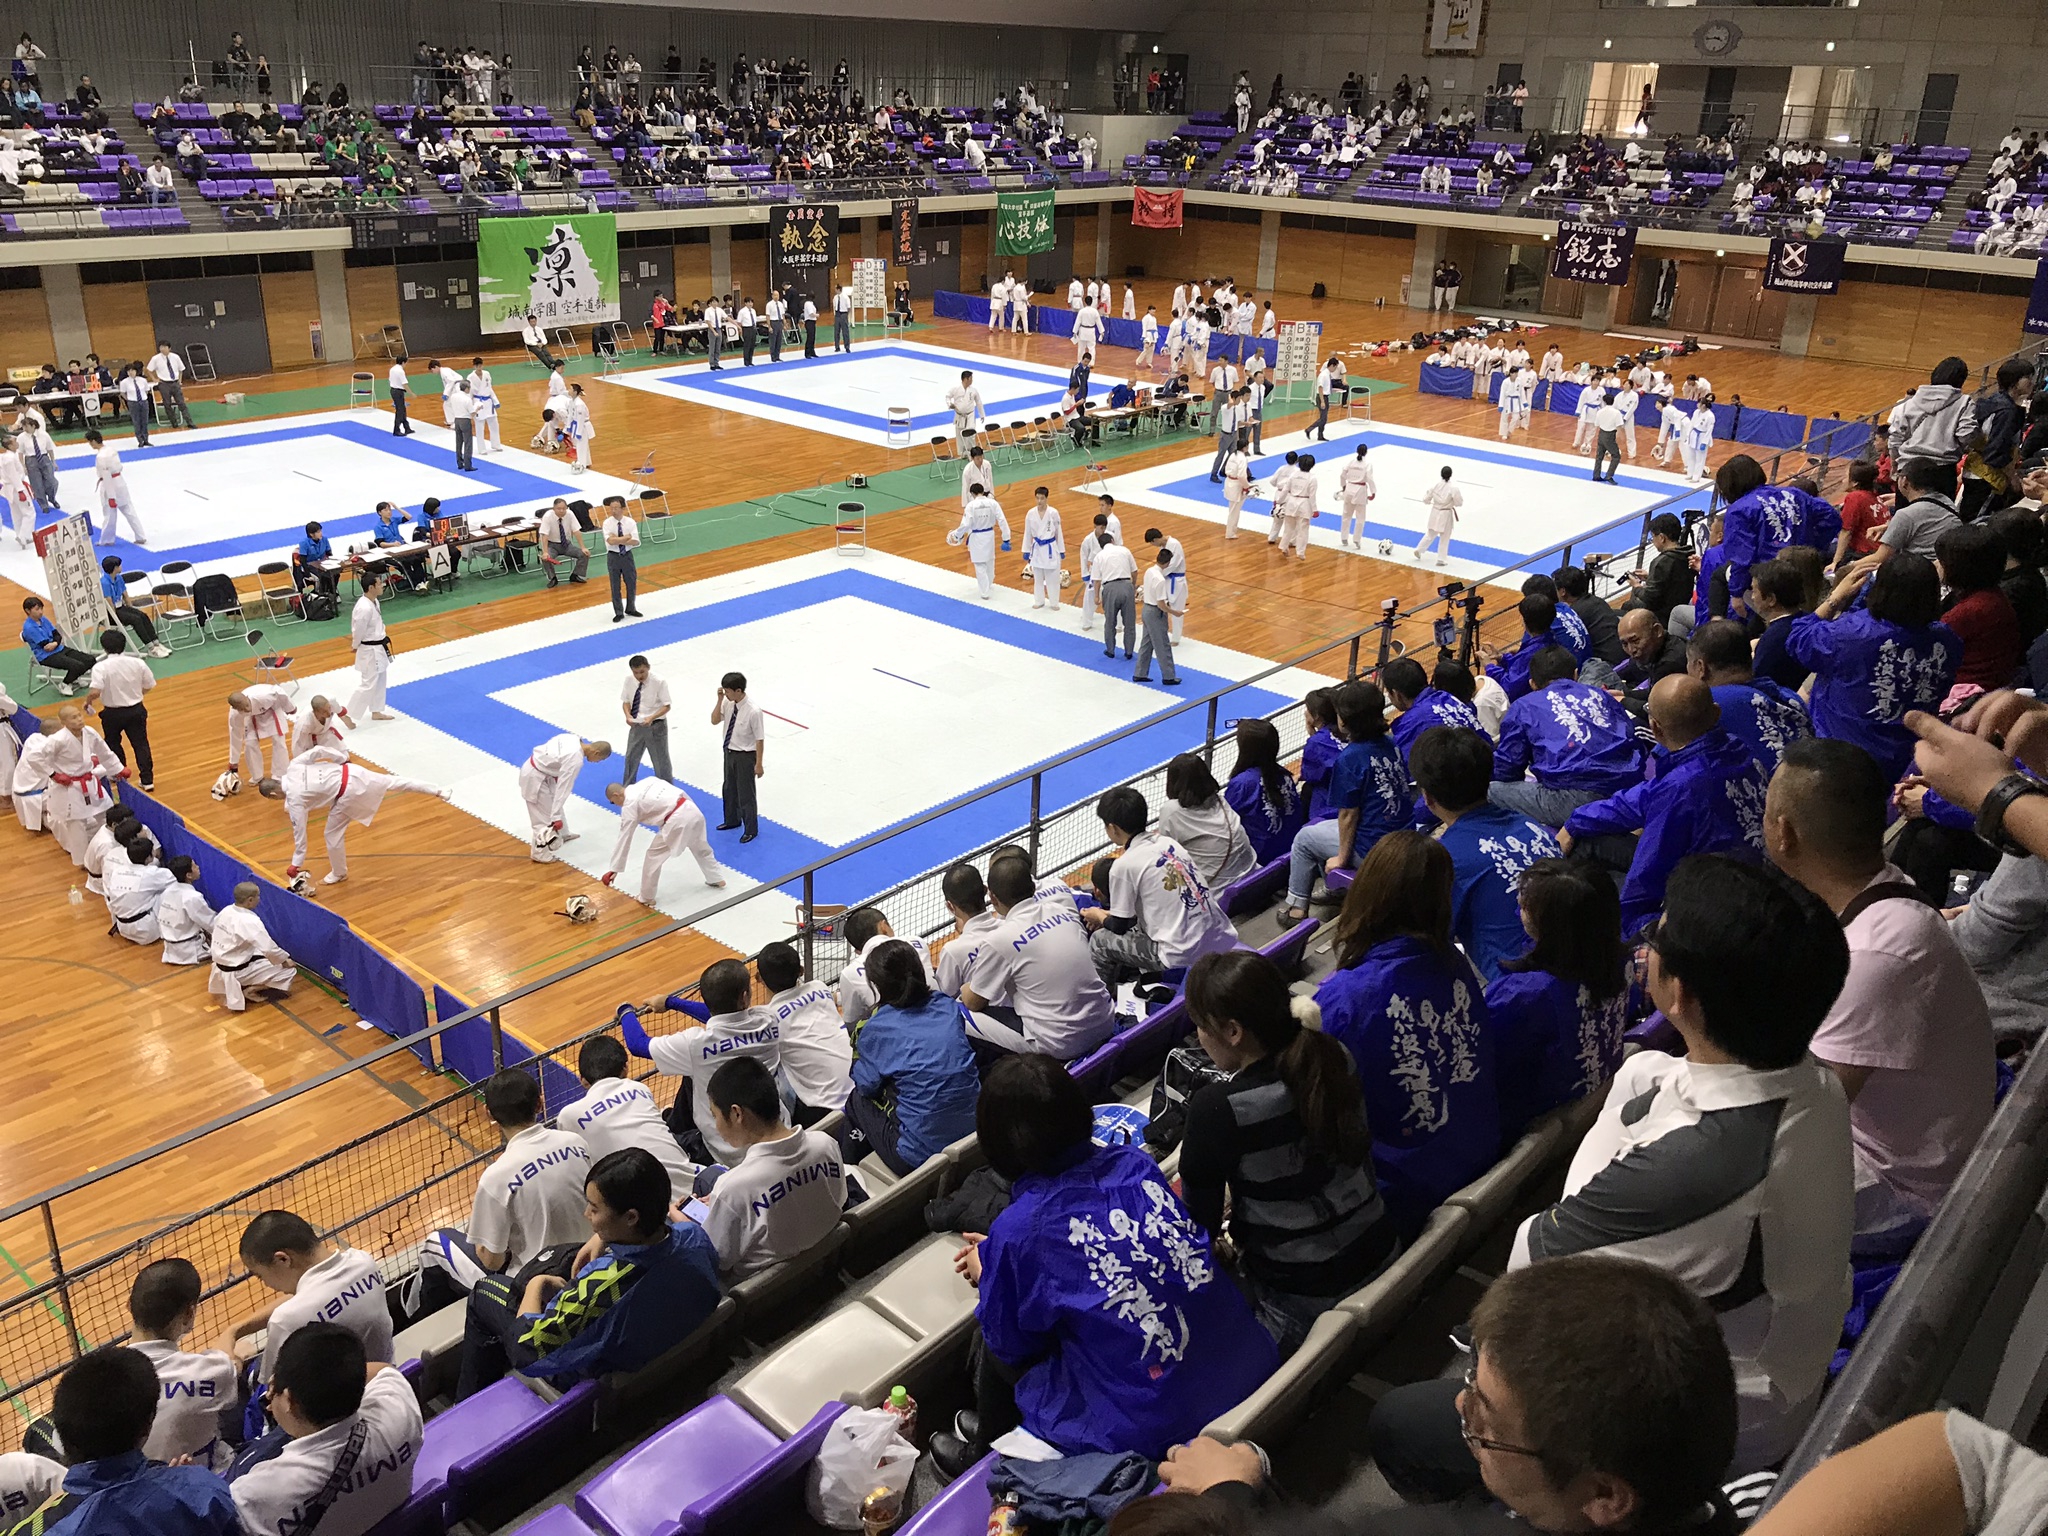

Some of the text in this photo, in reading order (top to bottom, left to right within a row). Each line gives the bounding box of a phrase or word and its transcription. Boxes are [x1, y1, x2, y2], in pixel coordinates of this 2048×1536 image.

[727, 326, 737, 337] D
[1297, 323, 1305, 334] B
[85, 398, 98, 412] C
[62, 525, 73, 543] A
[435, 551, 450, 570] A
